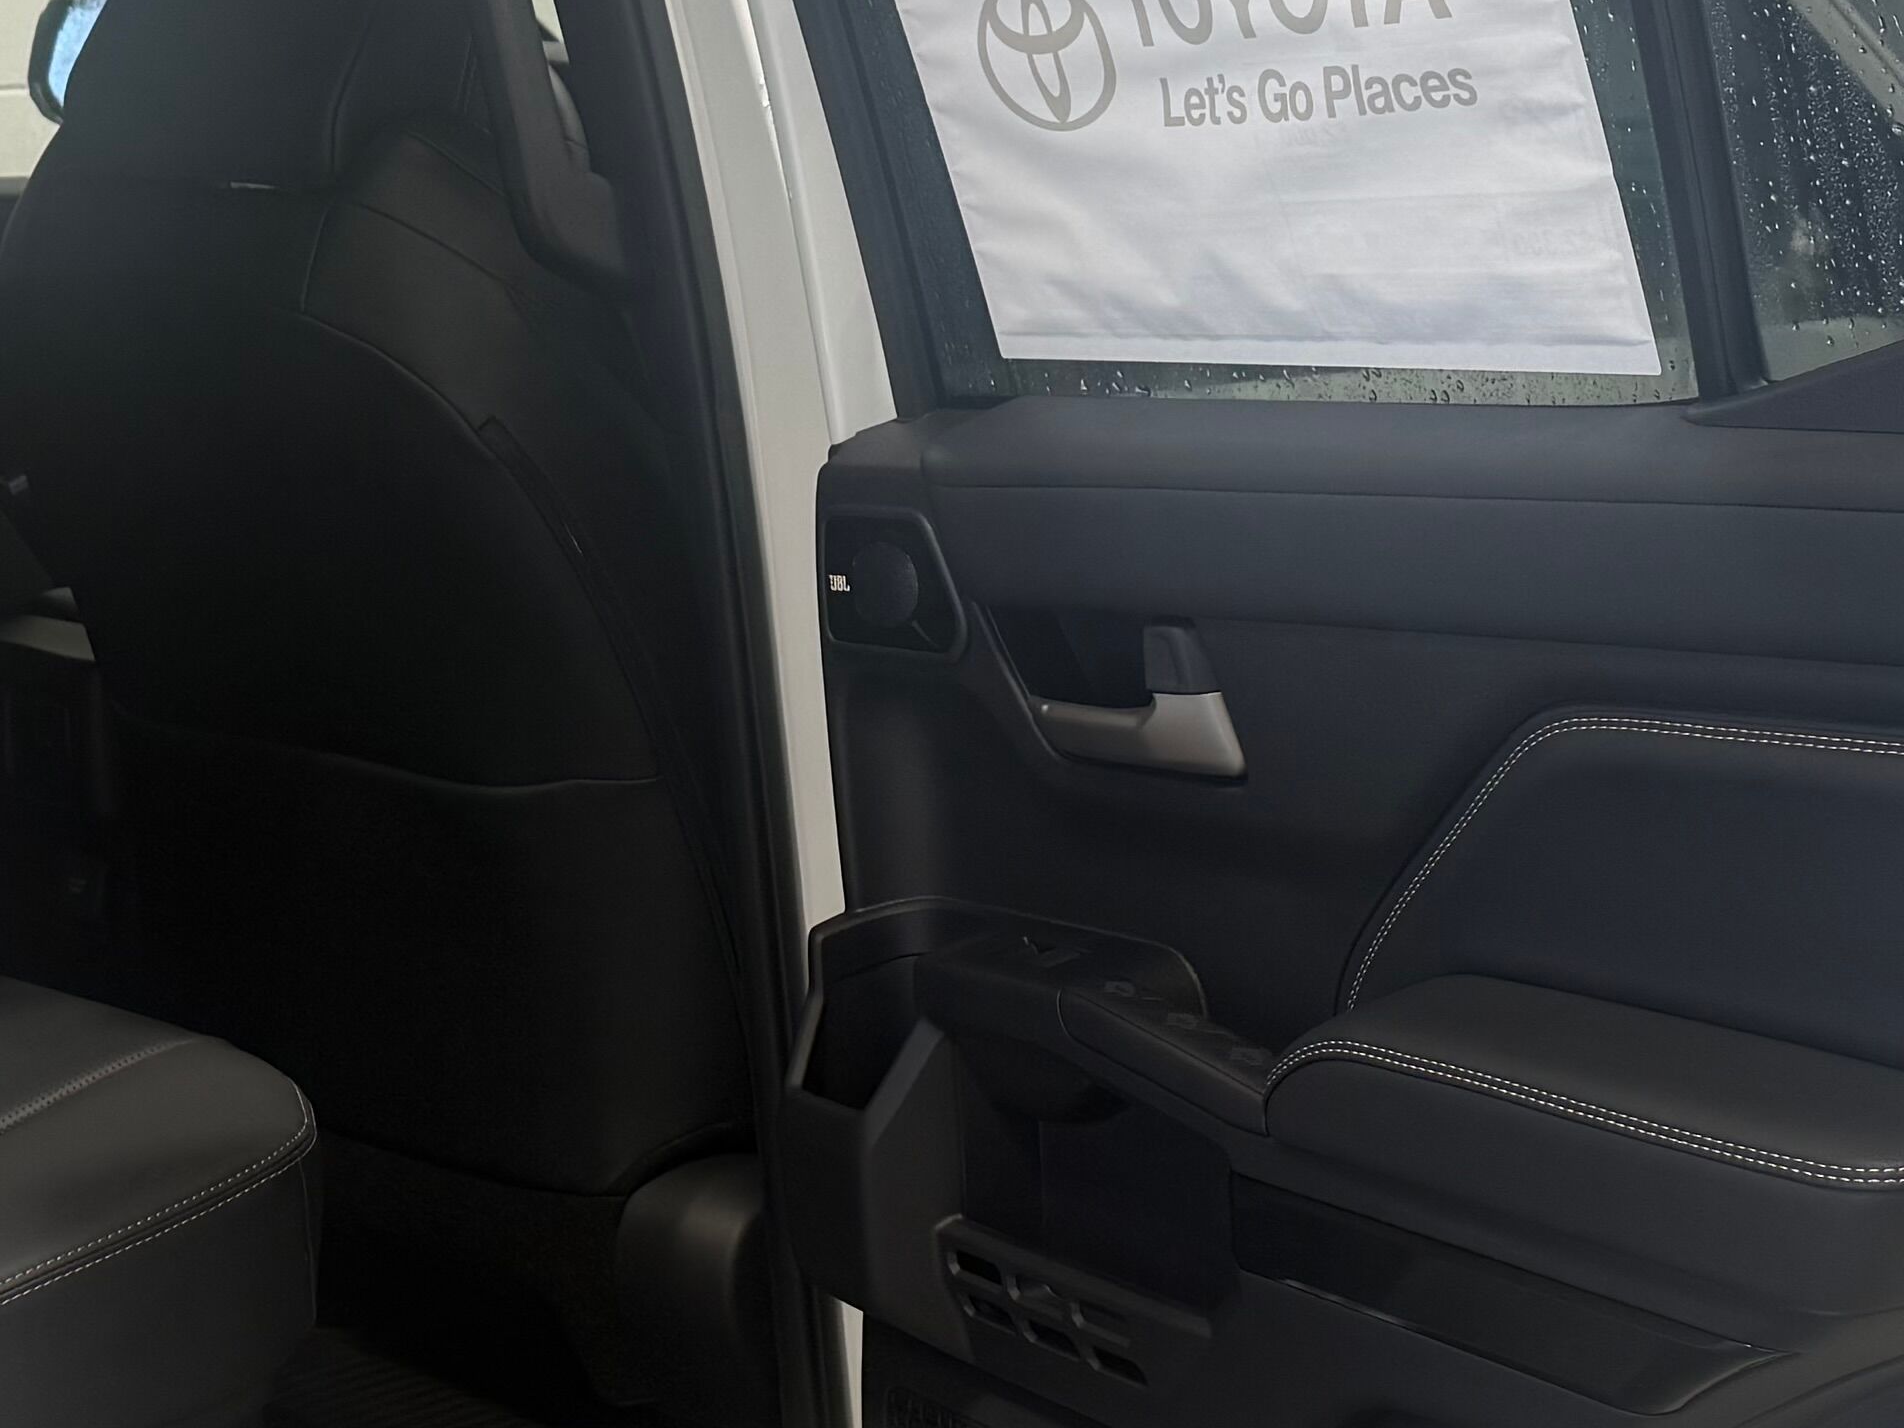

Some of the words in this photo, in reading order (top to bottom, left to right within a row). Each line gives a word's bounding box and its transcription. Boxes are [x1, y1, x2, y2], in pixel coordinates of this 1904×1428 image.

[1159, 73, 1247, 128] Let's
[1258, 69, 1314, 124] Go
[1323, 63, 1477, 119] Places
[829, 574, 850, 592] JBL
